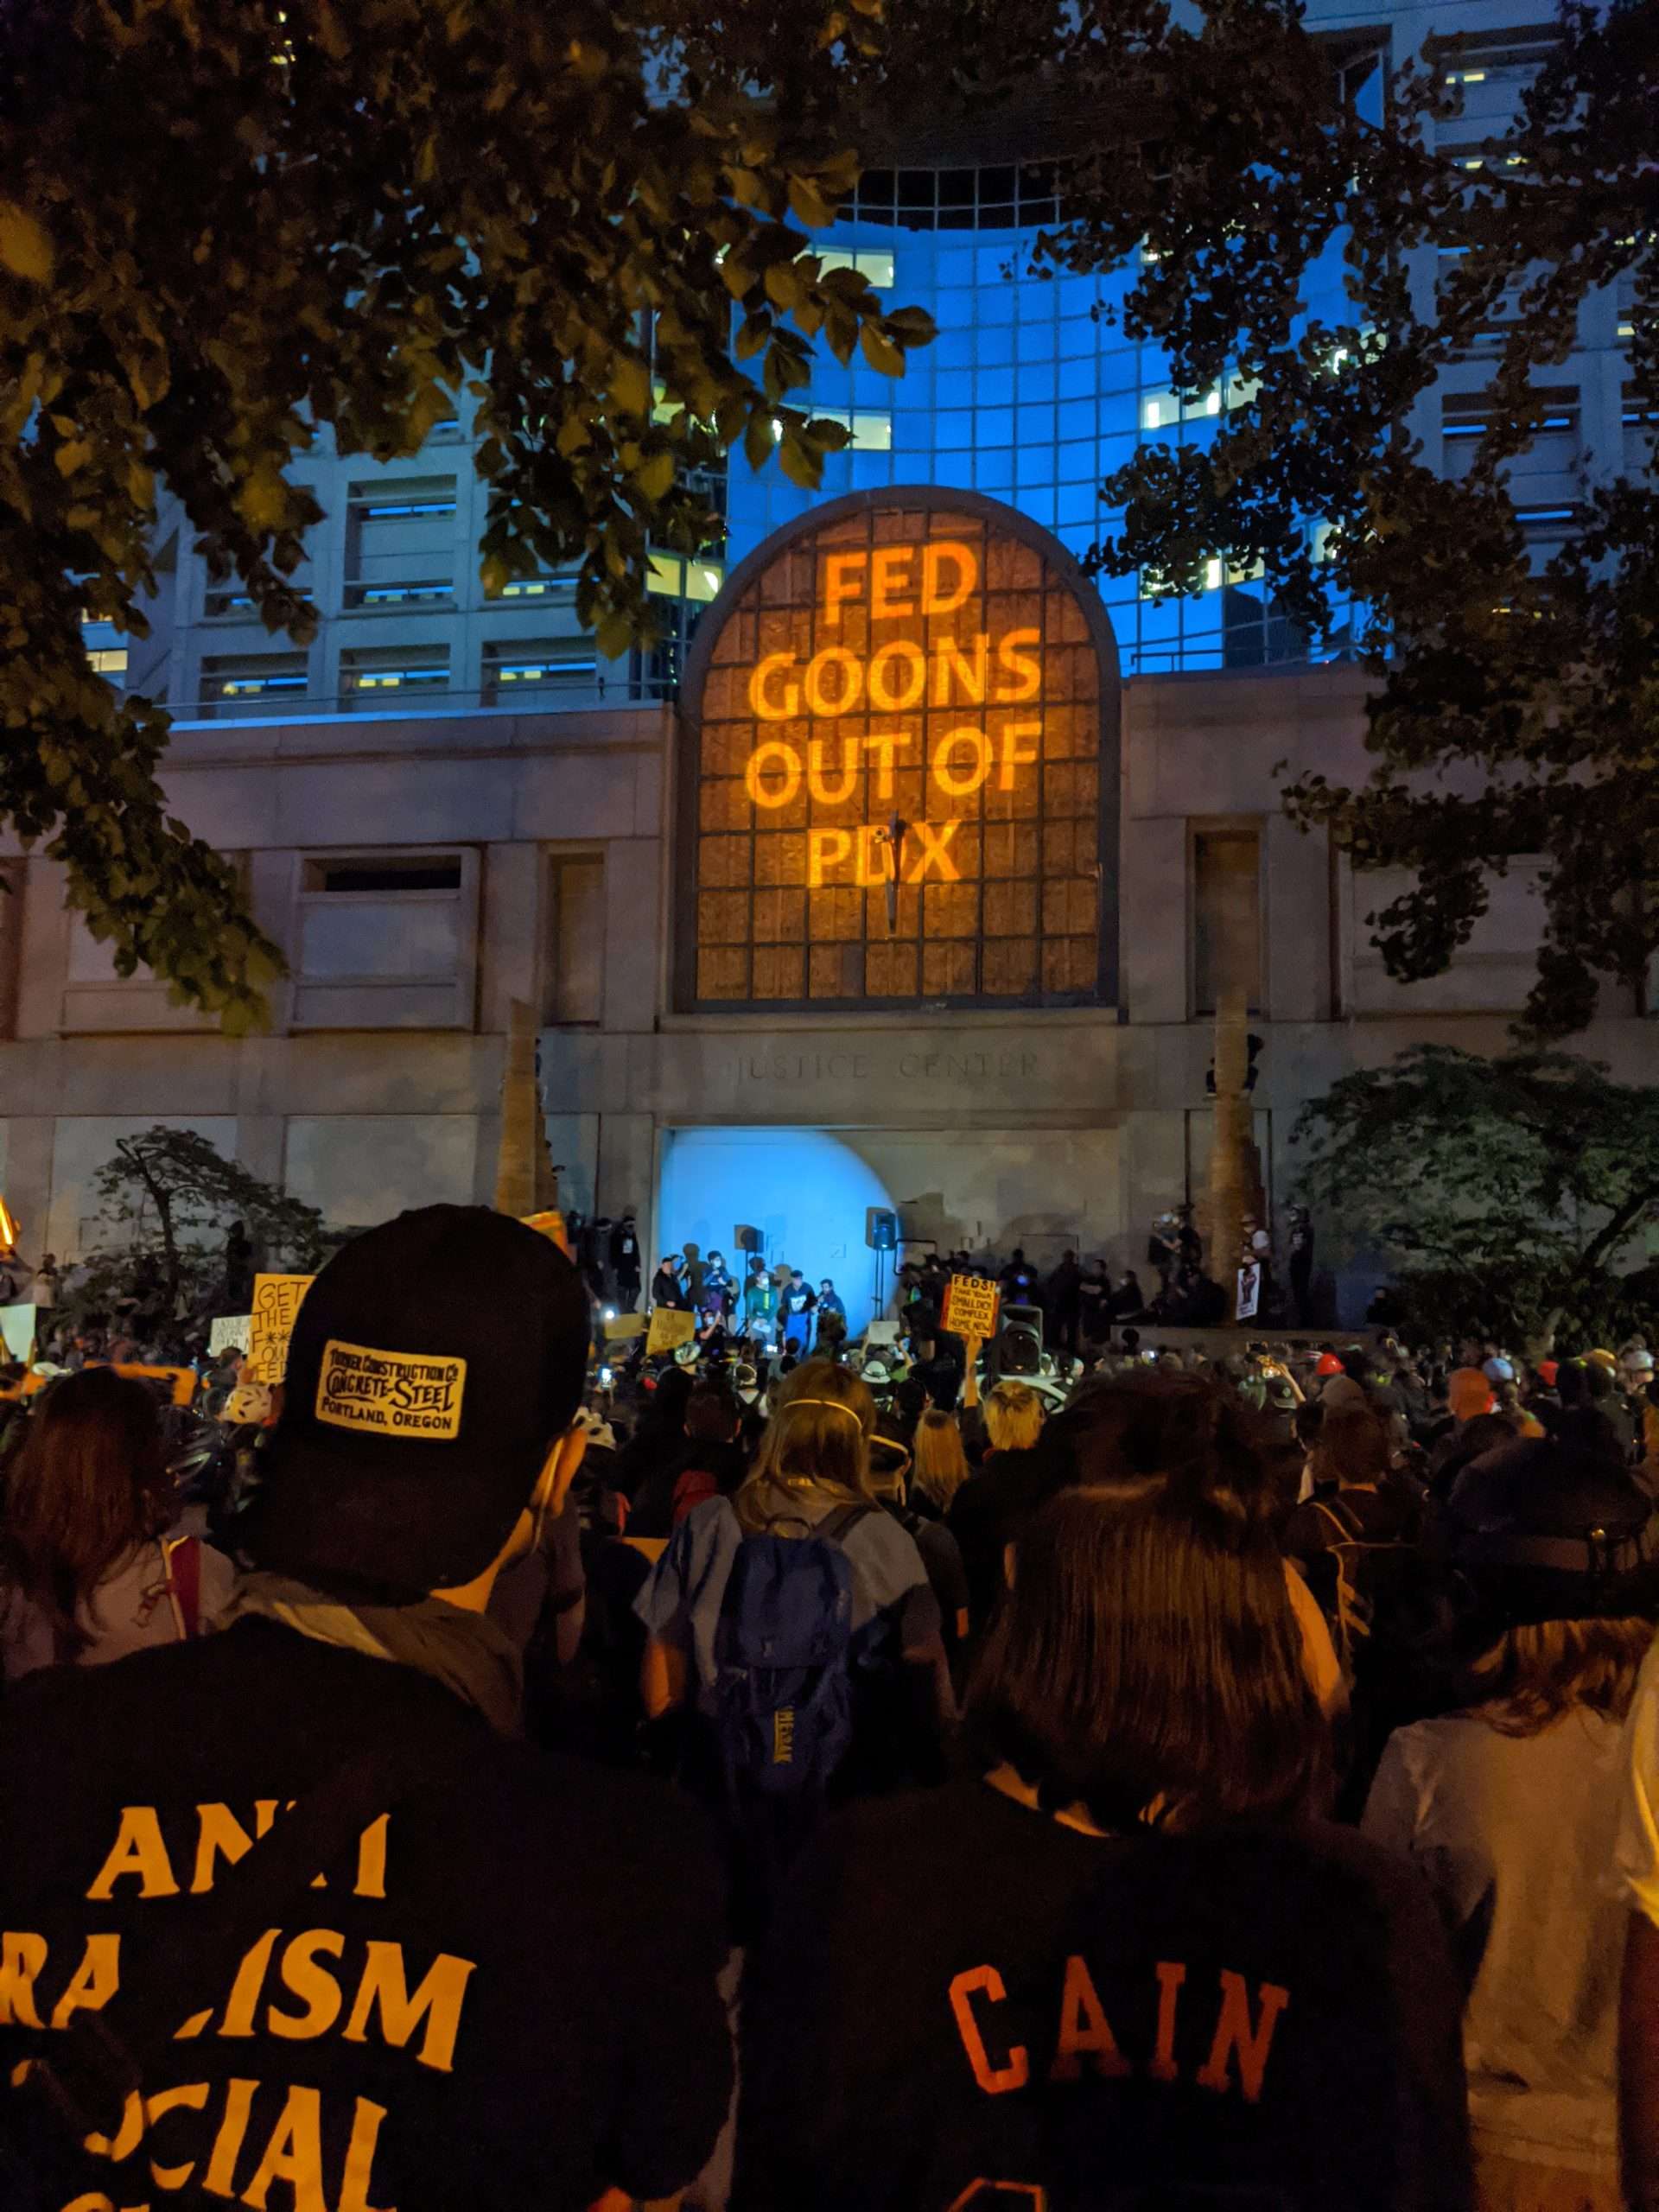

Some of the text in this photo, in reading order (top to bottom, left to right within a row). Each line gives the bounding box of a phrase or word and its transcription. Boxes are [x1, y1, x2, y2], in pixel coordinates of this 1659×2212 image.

[823, 540, 978, 626] FED
[748, 627, 1042, 721] GOONS
[746, 722, 1042, 809] OUT OF
[807, 819, 962, 888] PDX
[737, 1051, 1039, 1080] JUSTICE CENTER
[251, 1307, 291, 1329] THE
[257, 1281, 307, 1310] GET
[953, 1276, 994, 1292] FEDS!
[363, 1354, 444, 1382] CONSTRUCTION
[321, 1395, 453, 1430] PORTLAND, OREGON
[86, 1800, 390, 1900] ANI
[0, 1928, 478, 2073] RAISM
[949, 1955, 1290, 2103] CAIN
